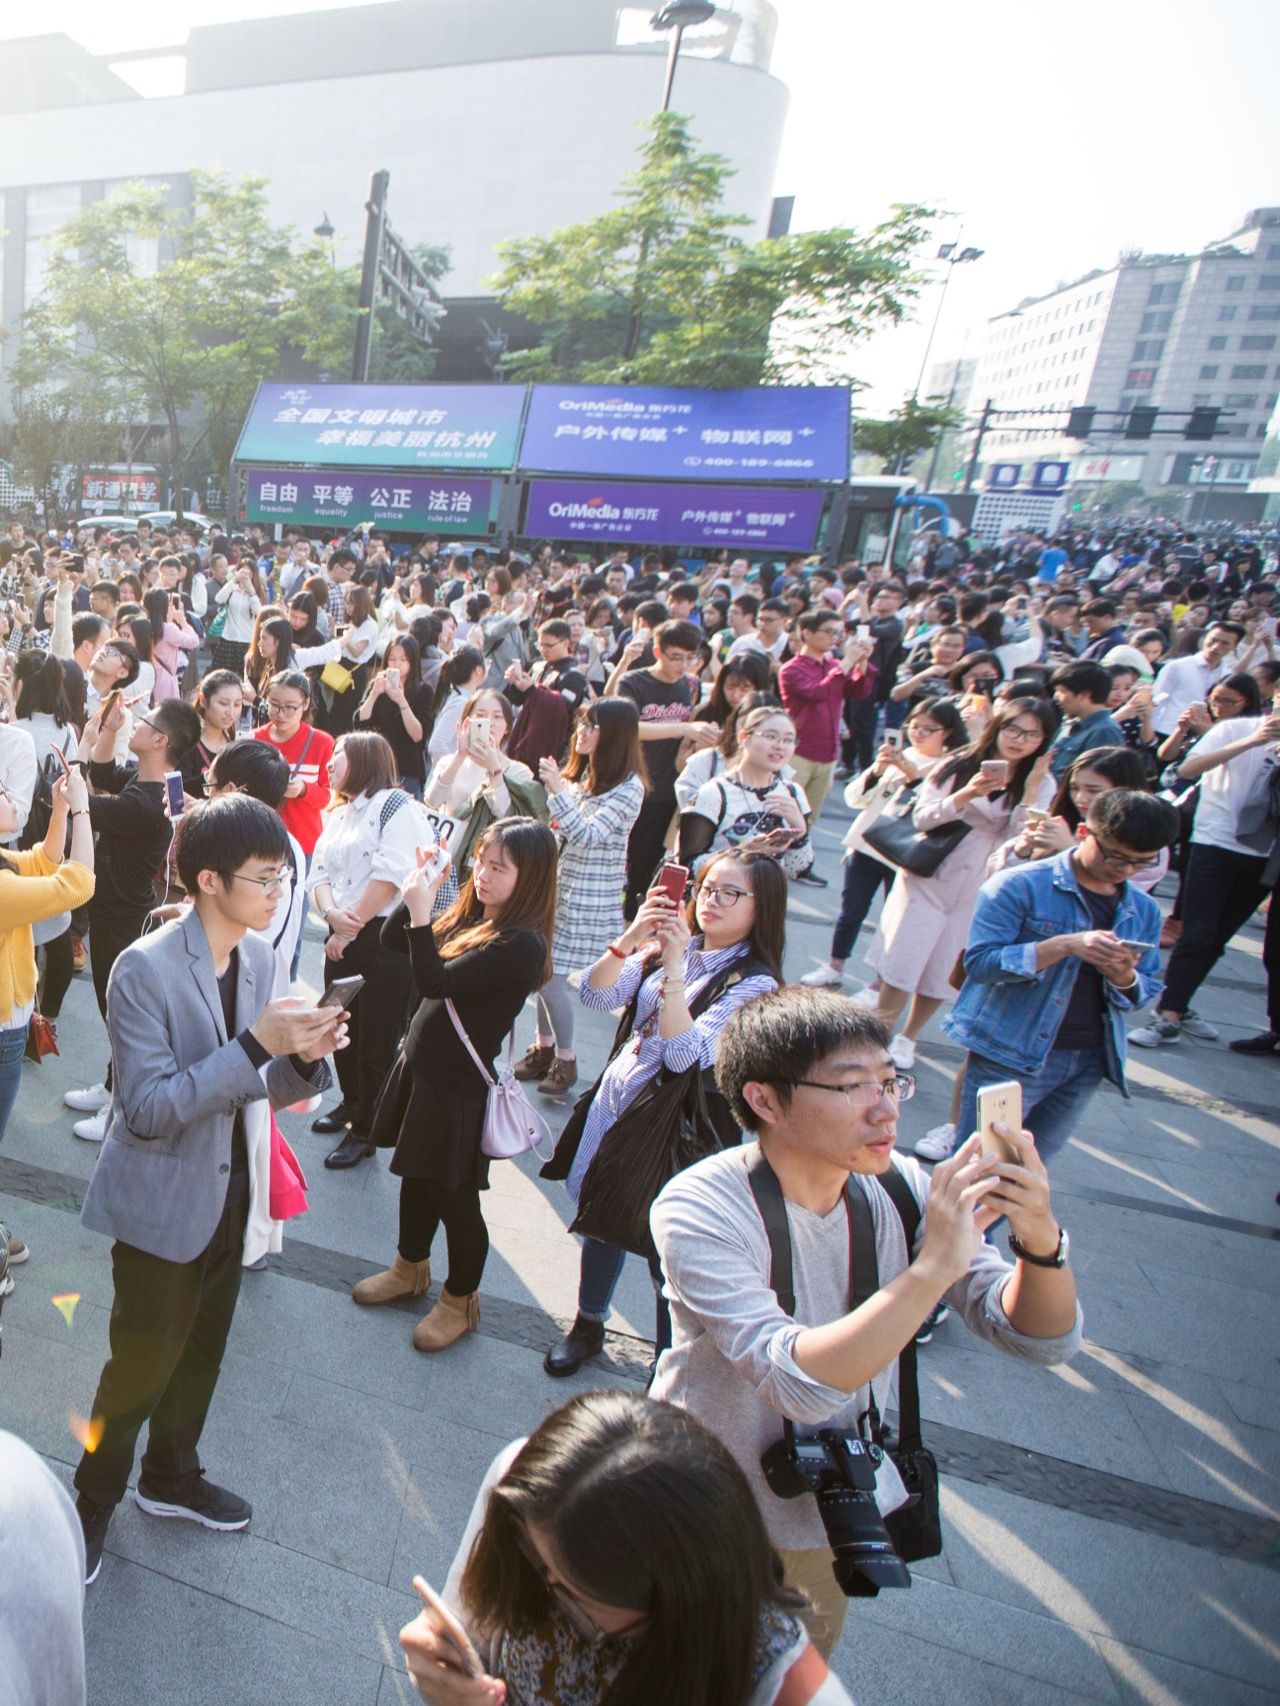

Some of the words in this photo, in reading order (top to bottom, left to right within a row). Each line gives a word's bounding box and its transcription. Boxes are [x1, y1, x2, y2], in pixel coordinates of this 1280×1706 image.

[558, 400, 645, 413] OriMedia
[274, 407, 448, 425] 全国文明城市
[315, 430, 497, 448] 幸福美丽杭州
[259, 482, 298, 503] 自由
[312, 484, 354, 507] 平等
[370, 487, 412, 509] 公正
[428, 490, 472, 513] 法治
[260, 504, 294, 514] freedom
[314, 507, 348, 518] equality
[374, 510, 404, 520] justice
[548, 502, 621, 520] OriMedia
